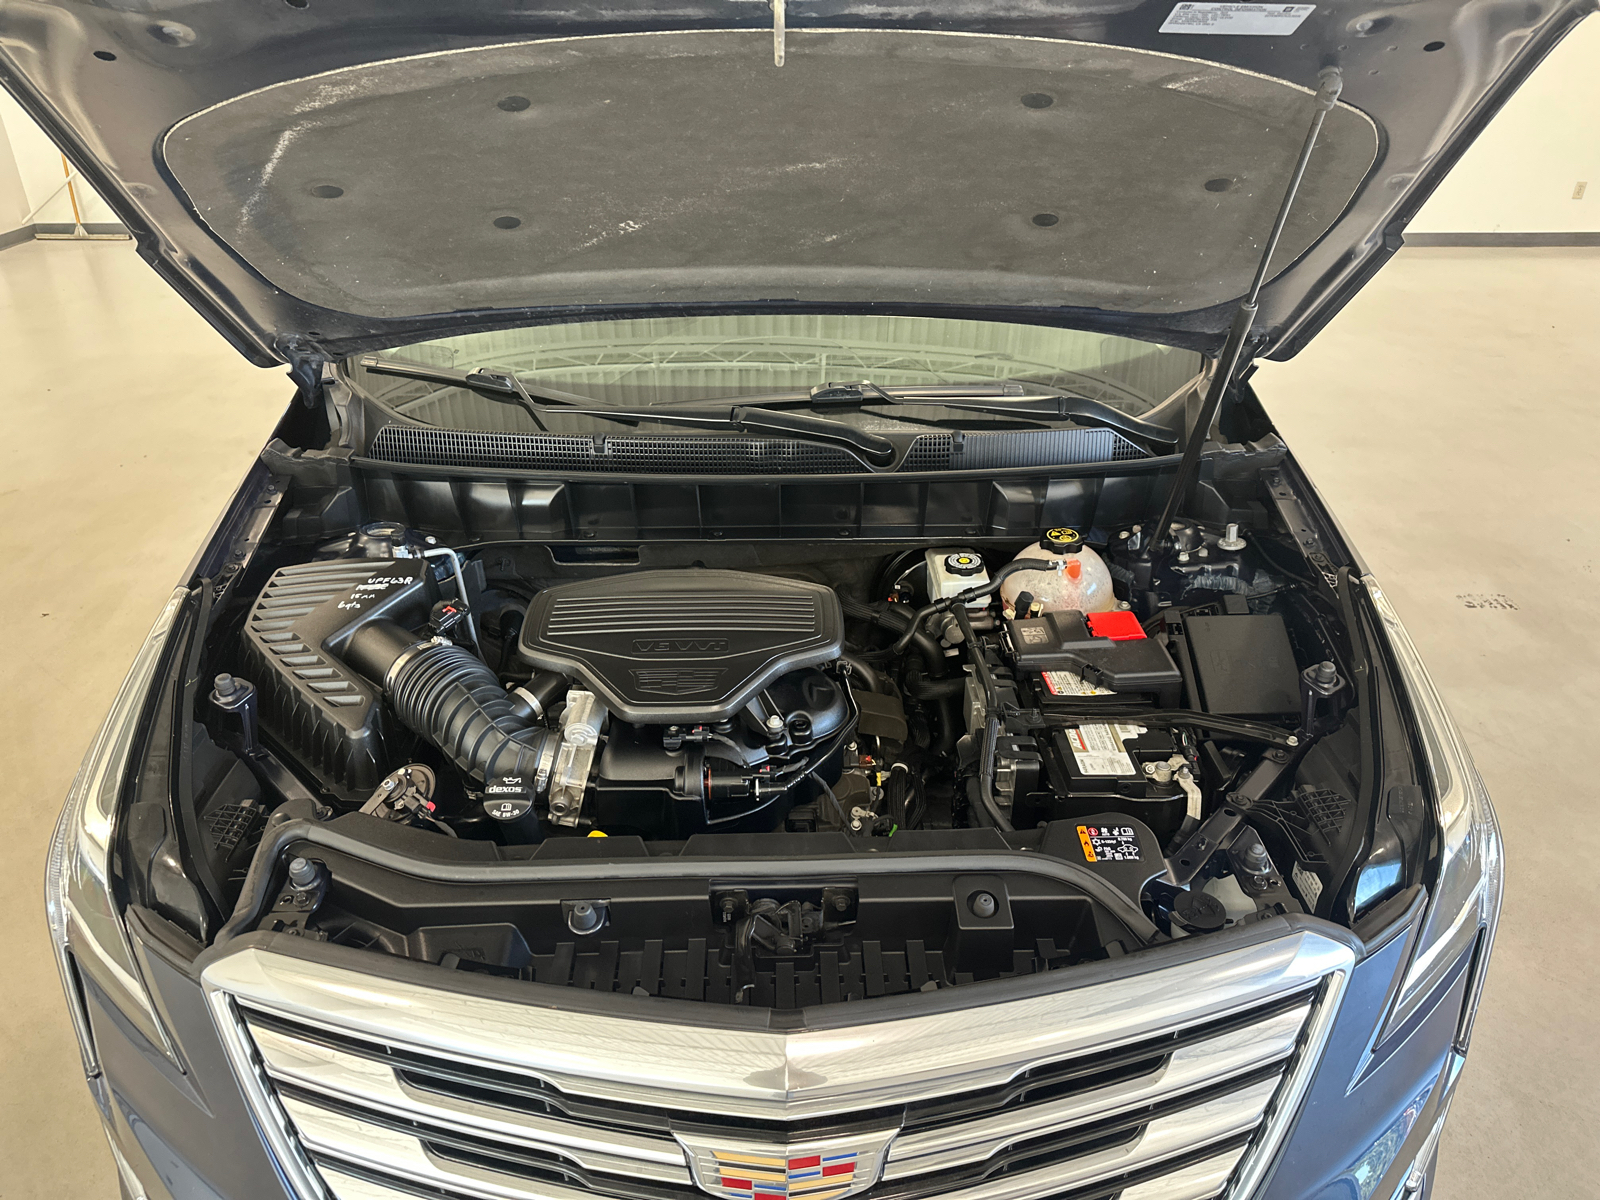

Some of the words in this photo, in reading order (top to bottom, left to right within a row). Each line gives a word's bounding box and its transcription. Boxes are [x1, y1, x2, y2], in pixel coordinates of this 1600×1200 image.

[367, 577, 413, 585] UPF63R
[635, 641, 670, 652] V6
[674, 641, 726, 651] VVT
[488, 785, 522, 794] dexos
